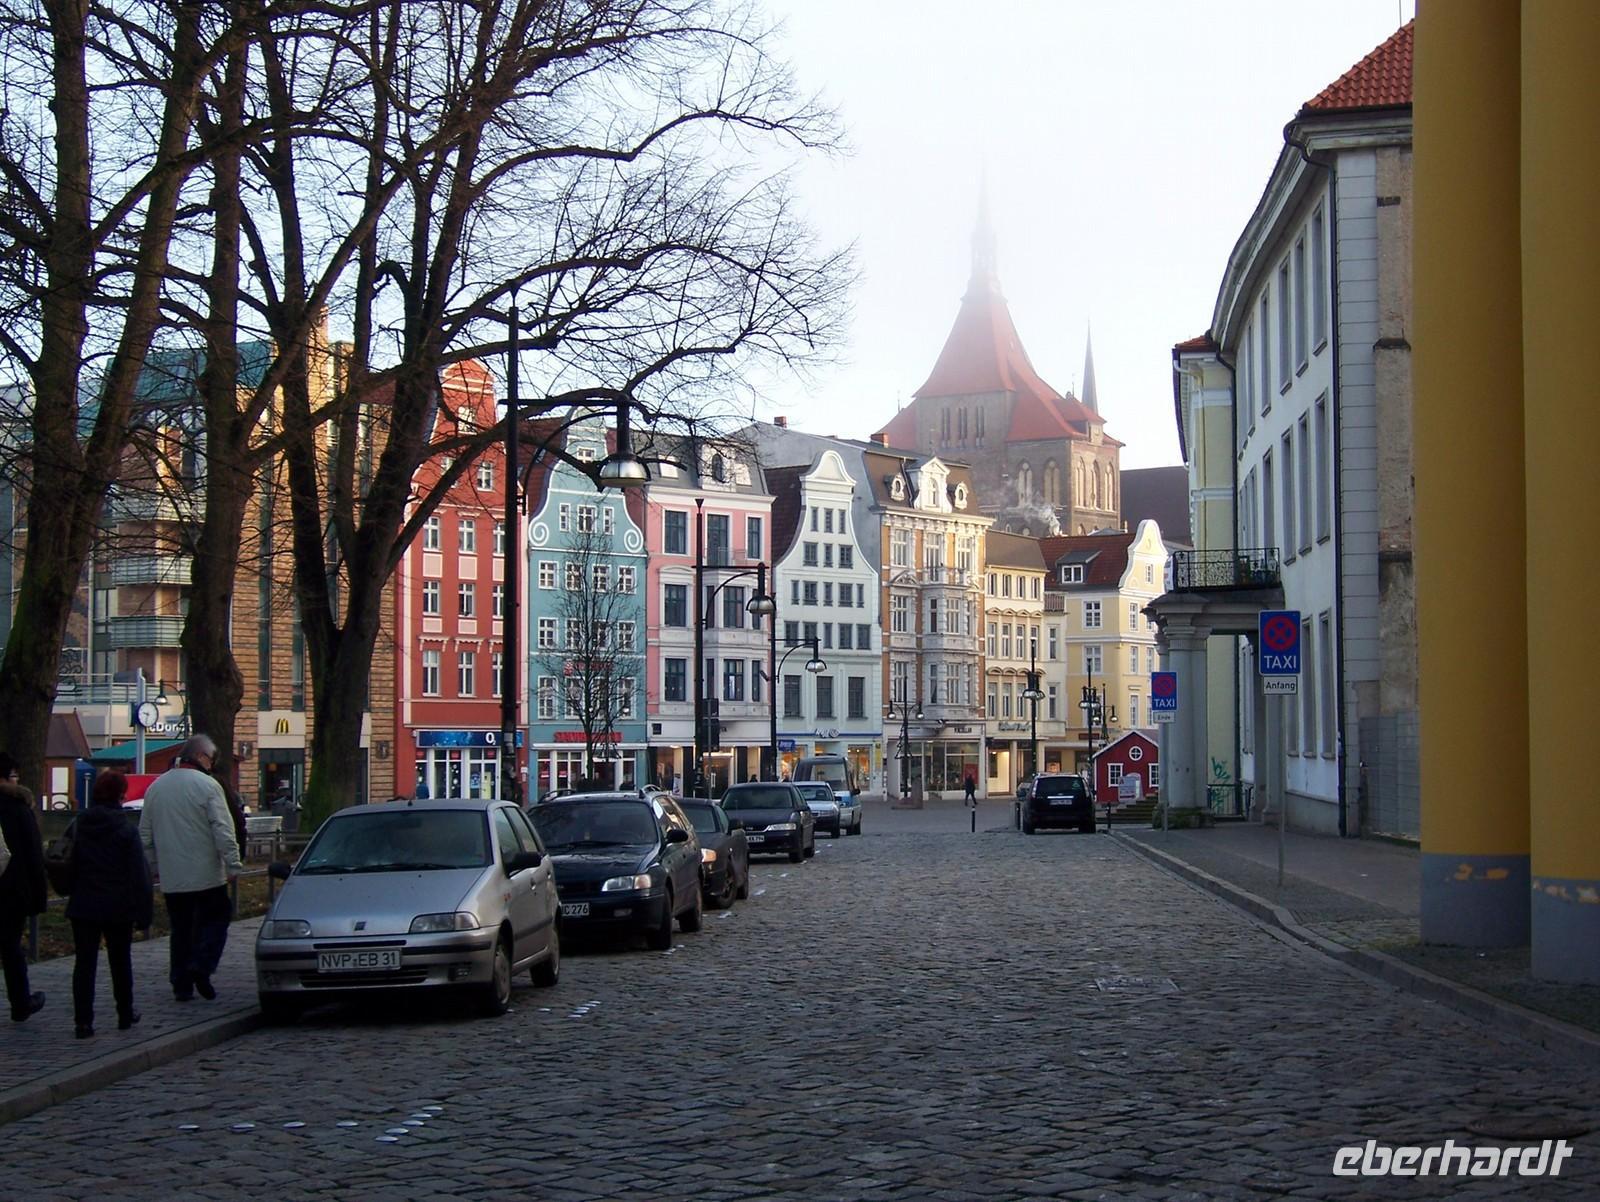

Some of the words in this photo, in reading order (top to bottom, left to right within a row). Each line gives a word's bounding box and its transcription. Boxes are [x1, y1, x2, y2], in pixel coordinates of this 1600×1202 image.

[1263, 655, 1297, 669] TAXI
[1265, 681, 1296, 691] Anfang
[1154, 698, 1175, 708] TAXI
[571, 903, 588, 914] 276
